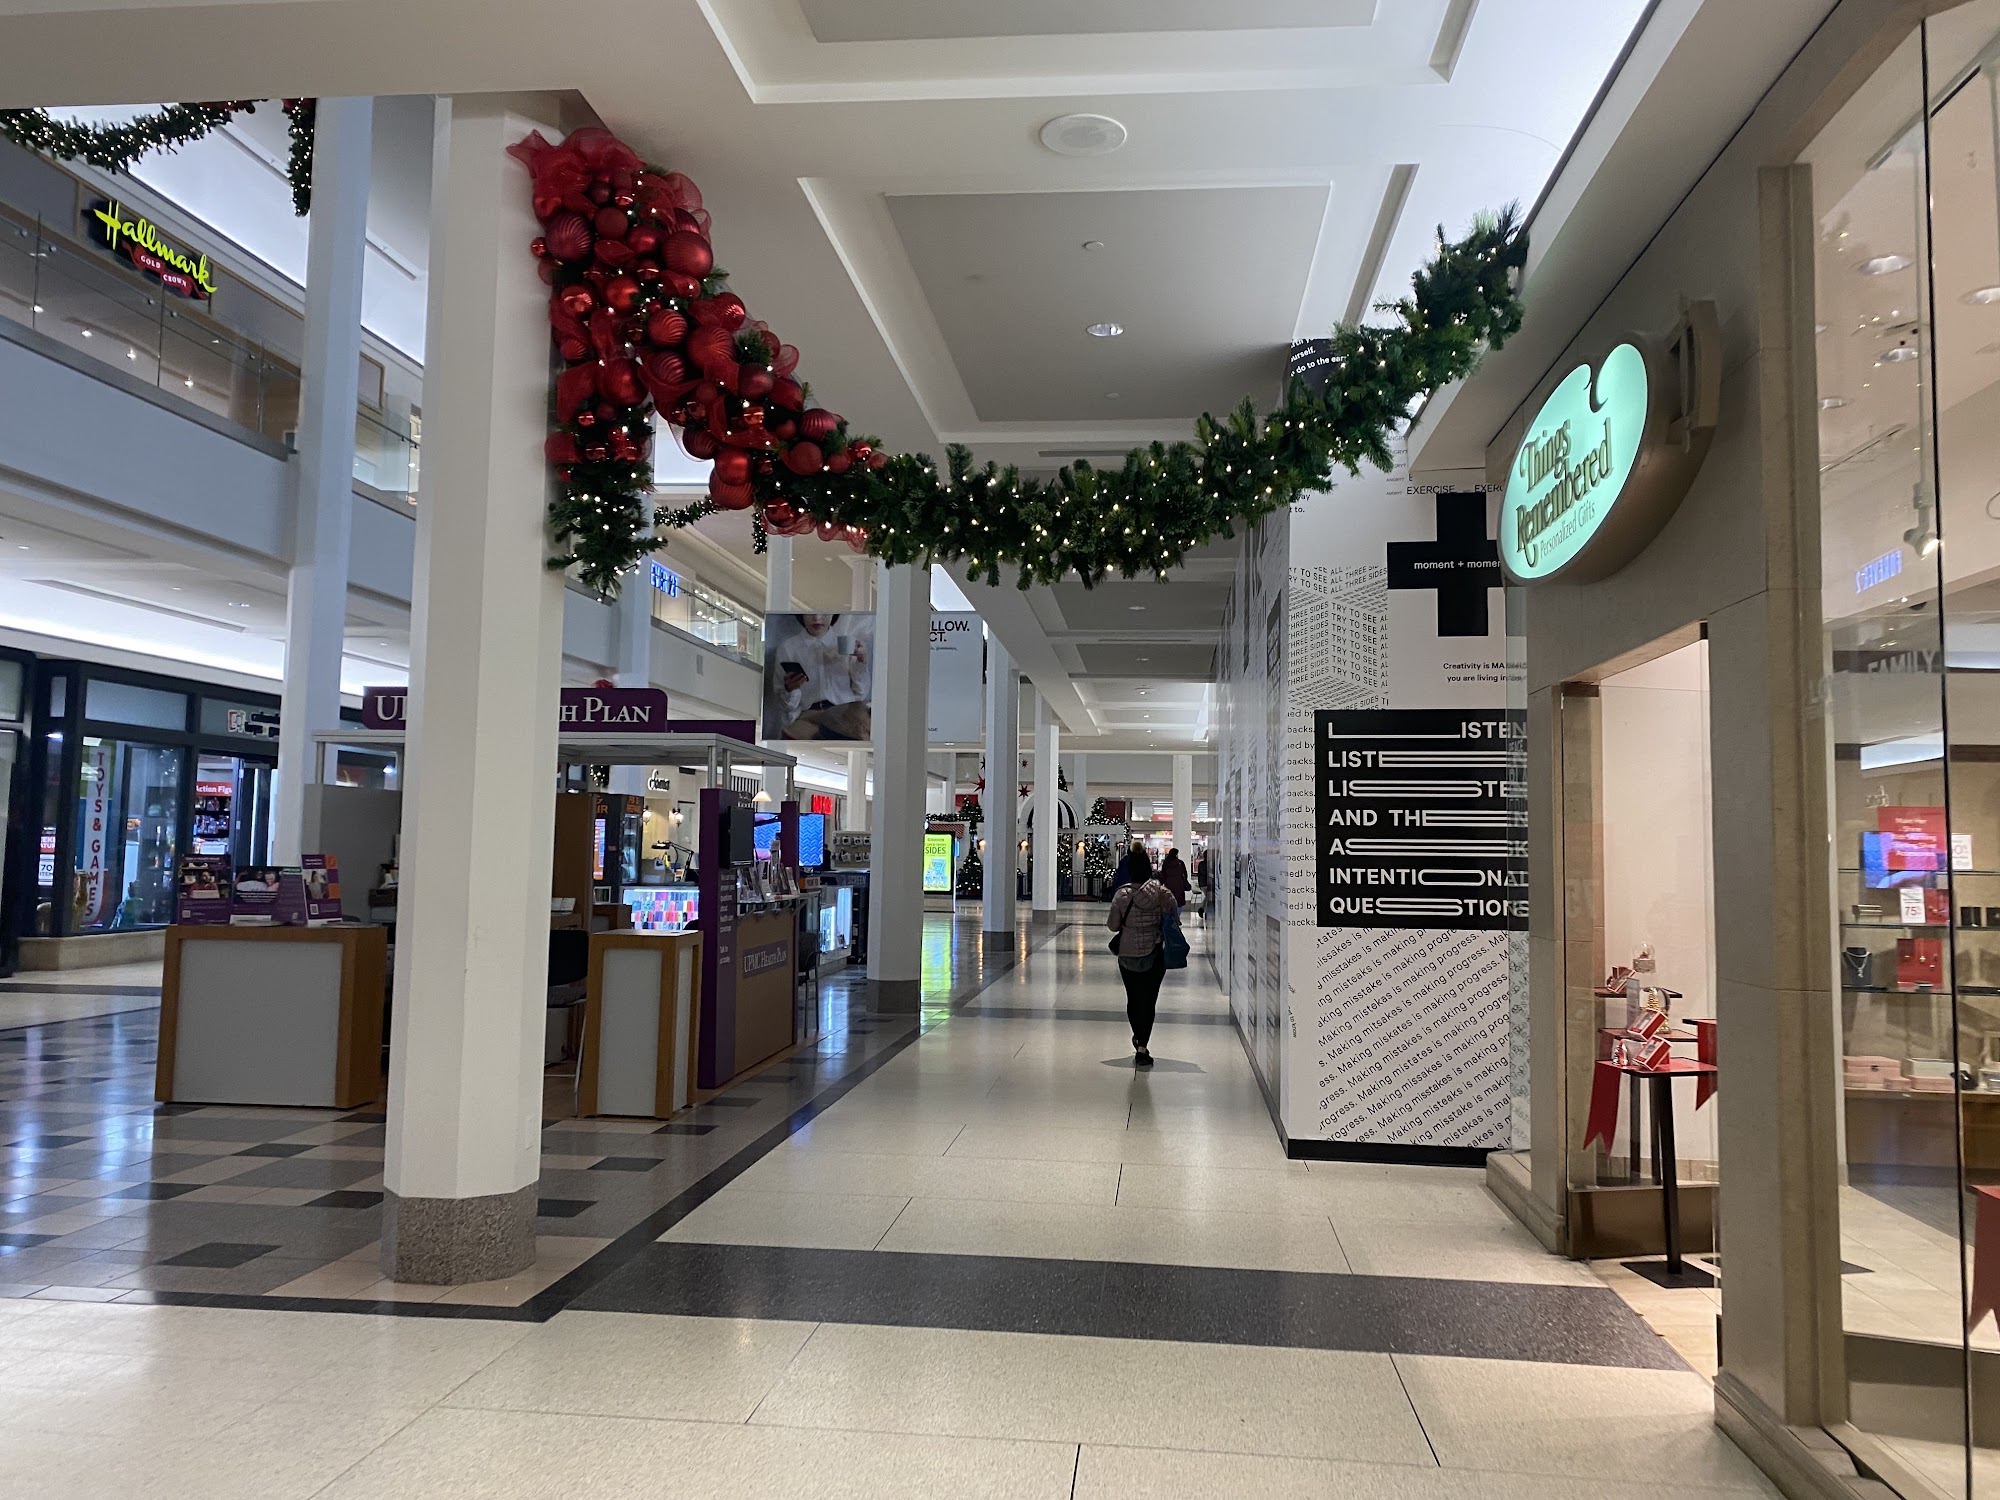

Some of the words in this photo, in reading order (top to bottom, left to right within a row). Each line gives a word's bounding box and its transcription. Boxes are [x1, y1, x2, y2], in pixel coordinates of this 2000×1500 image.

[93, 200, 217, 292] Hallmark
[140, 255, 160, 269] GOLD
[162, 274, 188, 287] CROWN
[1296, 366, 1306, 374] do
[1316, 357, 1330, 366] the
[1520, 419, 1571, 493] Things
[1406, 485, 1456, 495] EXERCISE
[1516, 417, 1614, 568] Remembered
[1540, 512, 1577, 558] Personalized
[1578, 500, 1596, 528] Gifts
[1414, 560, 1454, 570] moment
[1443, 662, 1482, 670] Creativity
[1476, 674, 1498, 683] living
[582, 696, 652, 723] PLAN
[94, 752, 104, 813] TOYS
[92, 817, 101, 832] &
[1328, 809, 1378, 826] AND
[925, 846, 946, 854] SIDES
[84, 839, 100, 917] GAMES
[1361, 945, 1371, 954] is
[1371, 958, 1381, 967] is
[1382, 935, 1416, 960] making
[1381, 972, 1392, 980] is
[1392, 948, 1426, 974] making
[1318, 1021, 1352, 1046] Making
[1391, 985, 1402, 994] is
[1402, 961, 1436, 987] making
[1436, 928, 1479, 965] progress.
[1326, 1034, 1362, 1060] Making
[1401, 999, 1412, 1007] is
[1412, 975, 1446, 1001] making
[1446, 946, 1489, 978] progress.
[1336, 1048, 1372, 1073] Making
[1411, 1012, 1422, 1021] is
[1422, 988, 1457, 1014] making
[1456, 960, 1500, 992] progress.
[1319, 1087, 1347, 1110] gress.
[1346, 1061, 1382, 1087] Making
[1382, 1033, 1422, 1063] mistakes
[1421, 1026, 1432, 1034] is
[1432, 1002, 1467, 1028] making
[1356, 1075, 1392, 1101] Making
[1431, 1039, 1442, 1048] is
[1442, 1015, 1477, 1041] making
[1366, 1089, 1402, 1115] Making
[1441, 1053, 1452, 1062] is
[1452, 1029, 1487, 1055] making
[1376, 1102, 1412, 1128] Making
[1451, 1067, 1462, 1076] is
[1463, 1043, 1498, 1069] making
[1386, 1116, 1422, 1146] Making
[1461, 1080, 1472, 1090] is
[1473, 1056, 1508, 1082] making
[1472, 1094, 1483, 1103] is
[1482, 1108, 1493, 1117] is
